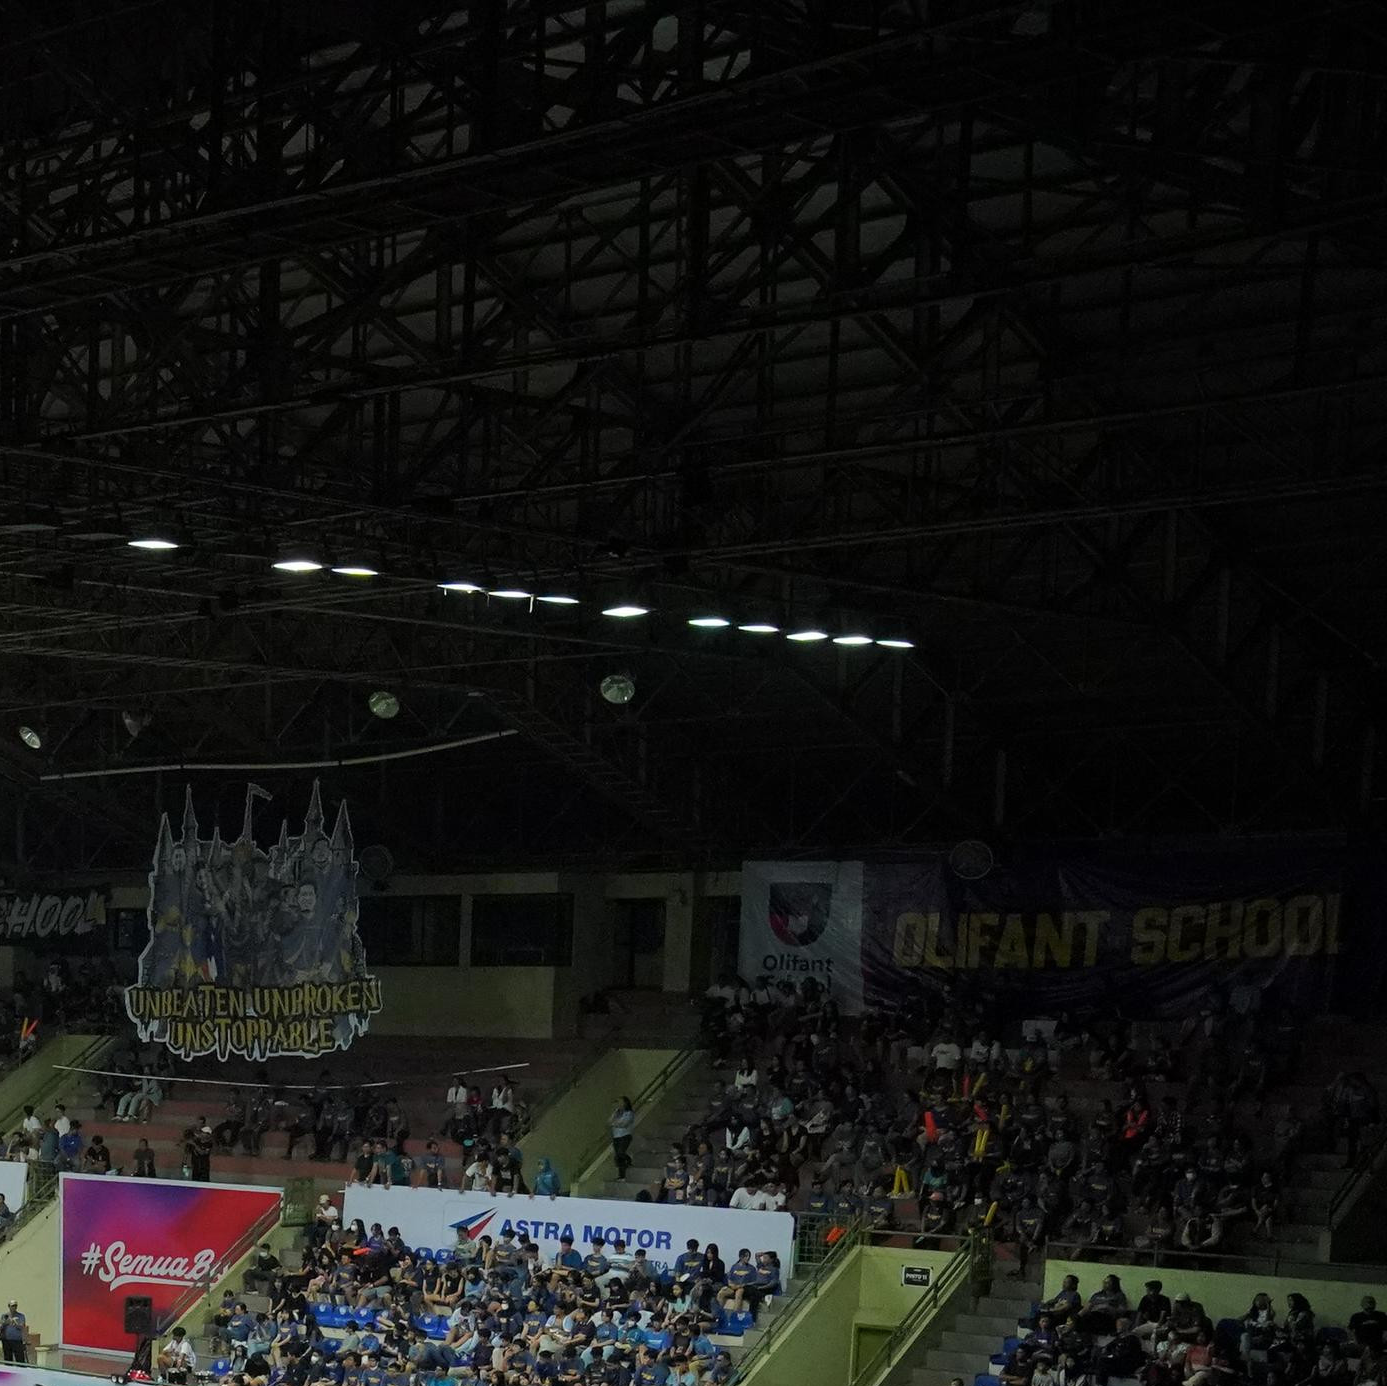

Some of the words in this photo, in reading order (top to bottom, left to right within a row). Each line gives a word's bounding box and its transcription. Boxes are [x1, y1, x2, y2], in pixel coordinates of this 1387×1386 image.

[893, 910, 1111, 970] OLIFANT
[763, 953, 834, 973] Olifant
[130, 983, 251, 1020] UNBEATEN
[254, 979, 381, 1016] UNBROKEN
[167, 1016, 335, 1058] UNSTOPPABLE
[499, 1218, 575, 1241] ASTRA
[582, 1224, 673, 1250] MOTOR
